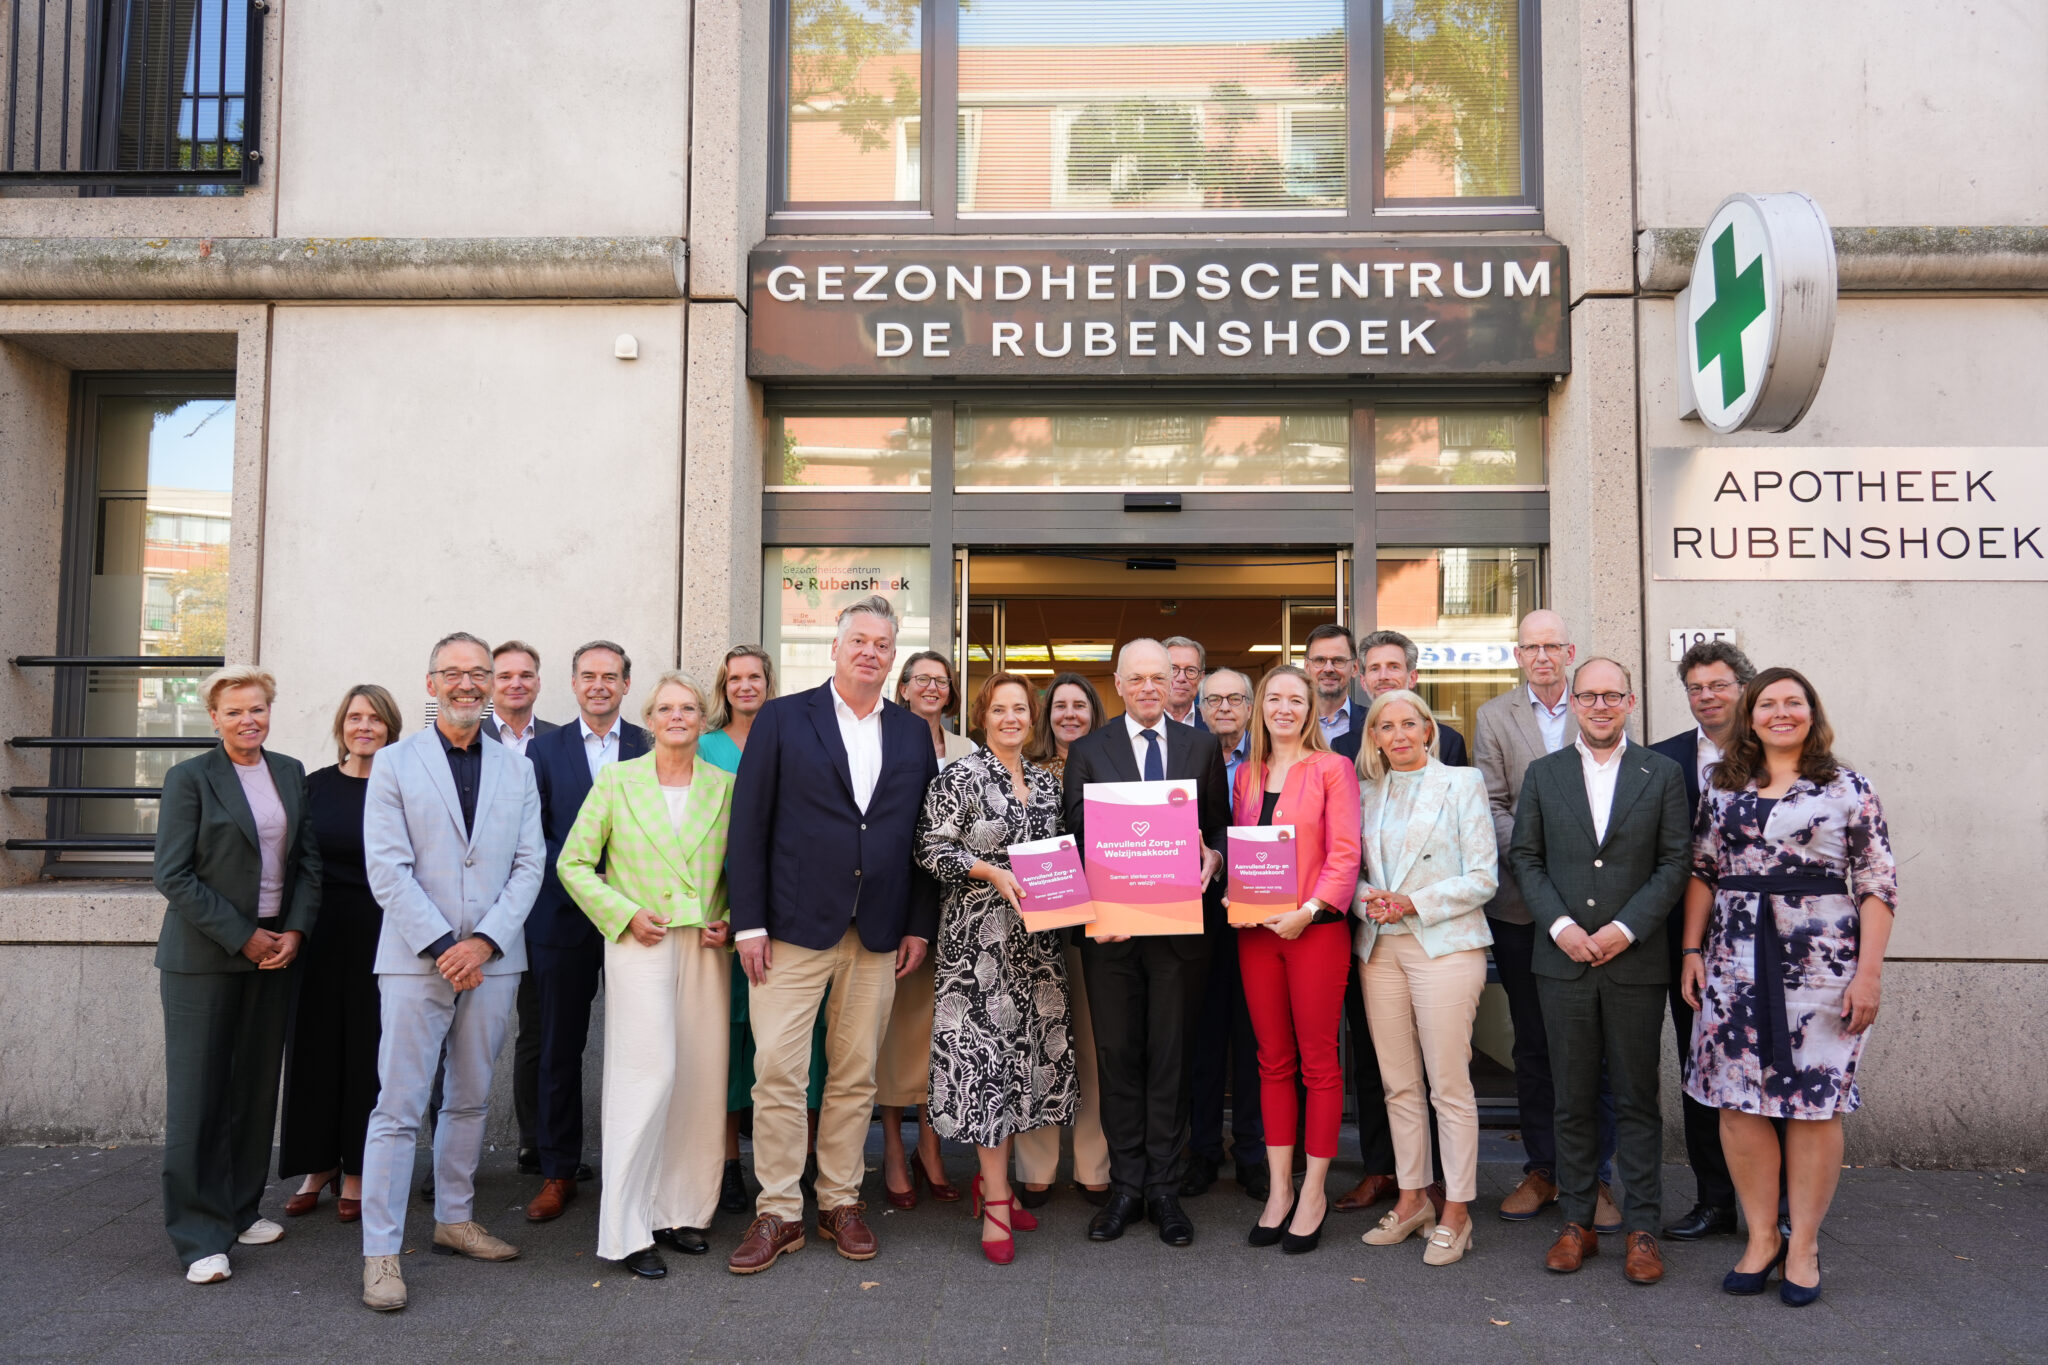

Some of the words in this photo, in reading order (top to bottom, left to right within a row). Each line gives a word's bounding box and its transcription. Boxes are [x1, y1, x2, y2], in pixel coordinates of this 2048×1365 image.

[766, 259, 1552, 303] GEZONDHEIDSCENTRUM
[874, 321, 951, 358] DE
[991, 317, 1438, 358] RUBENSHOEK
[1713, 470, 1997, 503] APOTHEEK
[1673, 526, 2045, 559] RUBENSHOEK
[783, 565, 881, 574] Gezondheidscentrum
[783, 577, 804, 591] De
[1096, 840, 1147, 849] Aanvullend
[1148, 840, 1174, 849] Zorg-
[1104, 848, 1179, 859] Welzijnsakkoord
